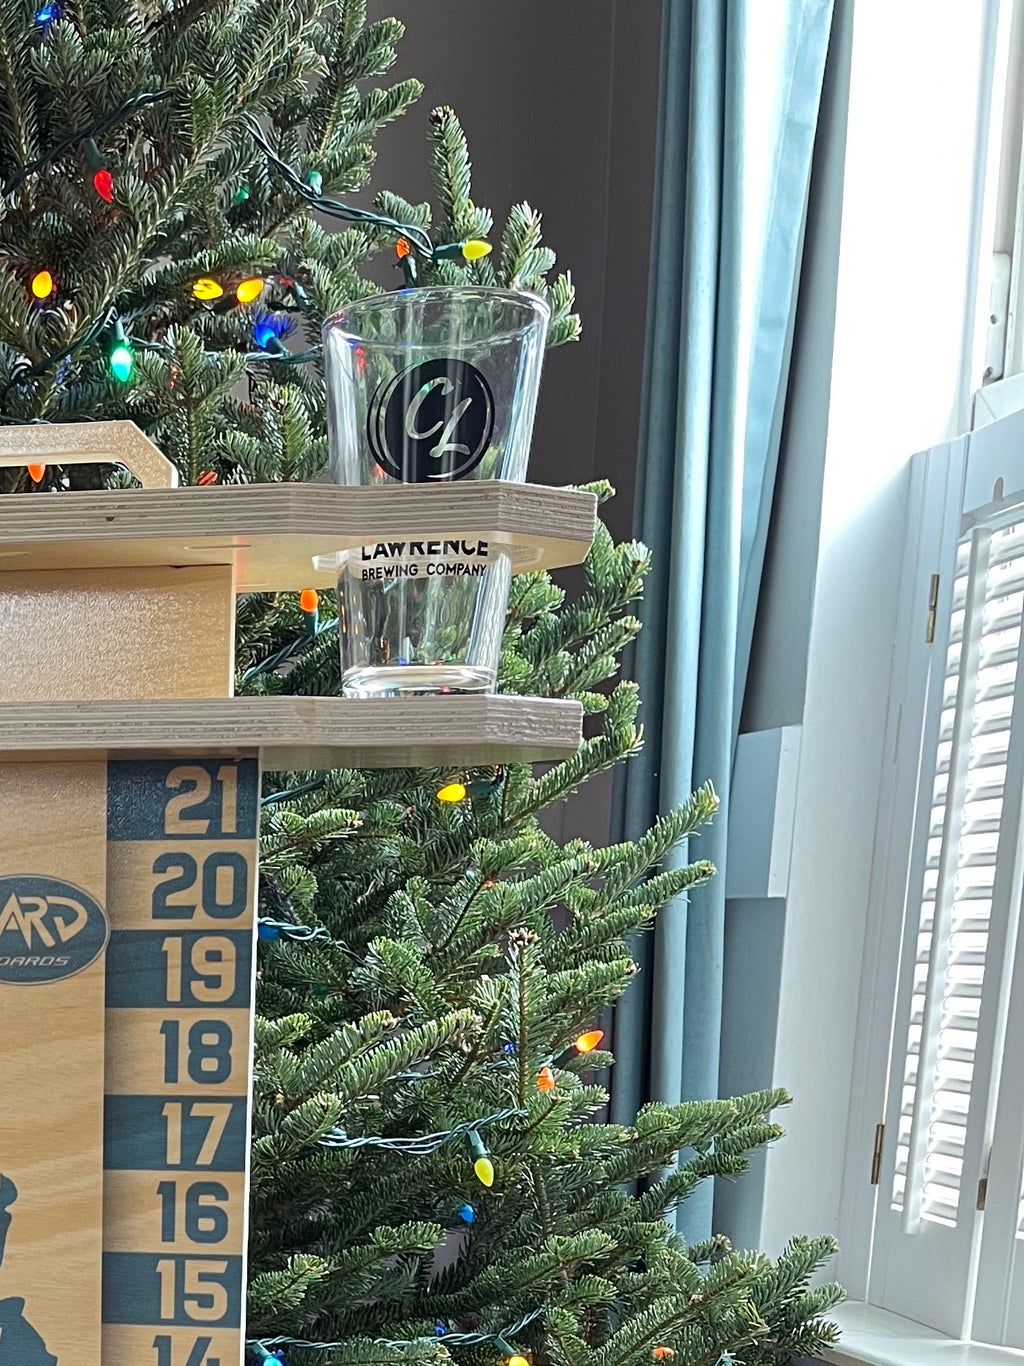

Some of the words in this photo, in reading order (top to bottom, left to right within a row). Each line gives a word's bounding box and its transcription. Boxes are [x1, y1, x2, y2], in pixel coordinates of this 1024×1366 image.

[361, 540, 488, 560] LAWRENCE
[362, 563, 418, 581] BREWING
[426, 563, 487, 577] COMPANY
[164, 766, 237, 834] 21
[152, 852, 247, 920] 20
[162, 936, 236, 1002] 19
[160, 1019, 232, 1084] 18
[162, 1102, 232, 1165] 17
[156, 1181, 228, 1243] 16
[156, 1260, 228, 1320] 15
